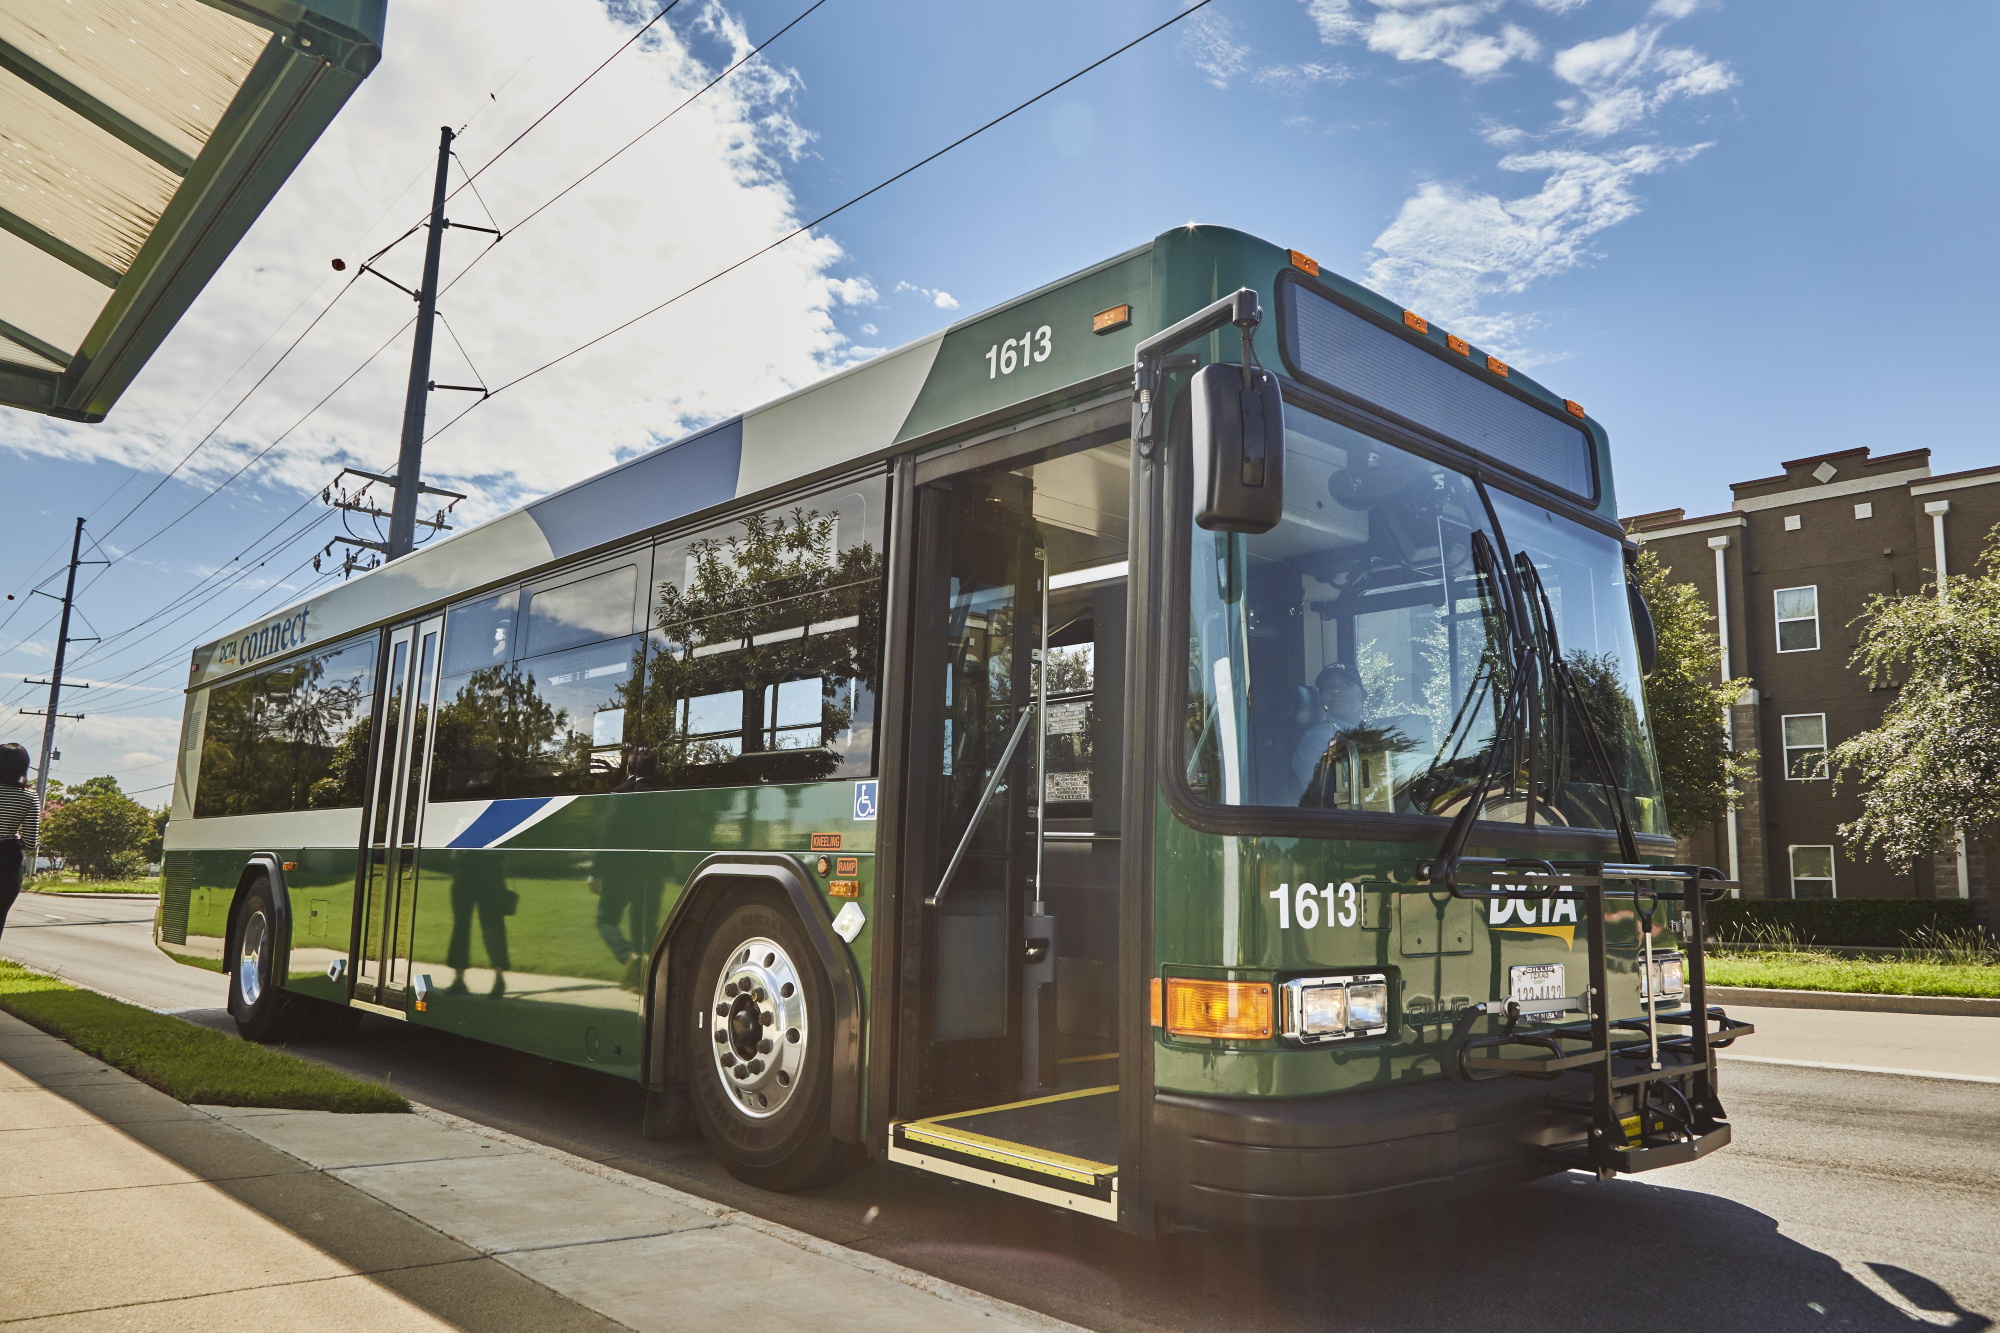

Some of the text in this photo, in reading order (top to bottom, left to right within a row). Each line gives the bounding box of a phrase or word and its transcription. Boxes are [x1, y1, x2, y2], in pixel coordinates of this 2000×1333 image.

[985, 325, 1052, 380] 1613
[219, 641, 237, 662] DCTA
[239, 604, 310, 665] connect
[813, 836, 840, 847] KNEELING
[838, 861, 856, 872] RAMP
[1269, 882, 1357, 930] 1613
[1489, 871, 1578, 925] DCTA
